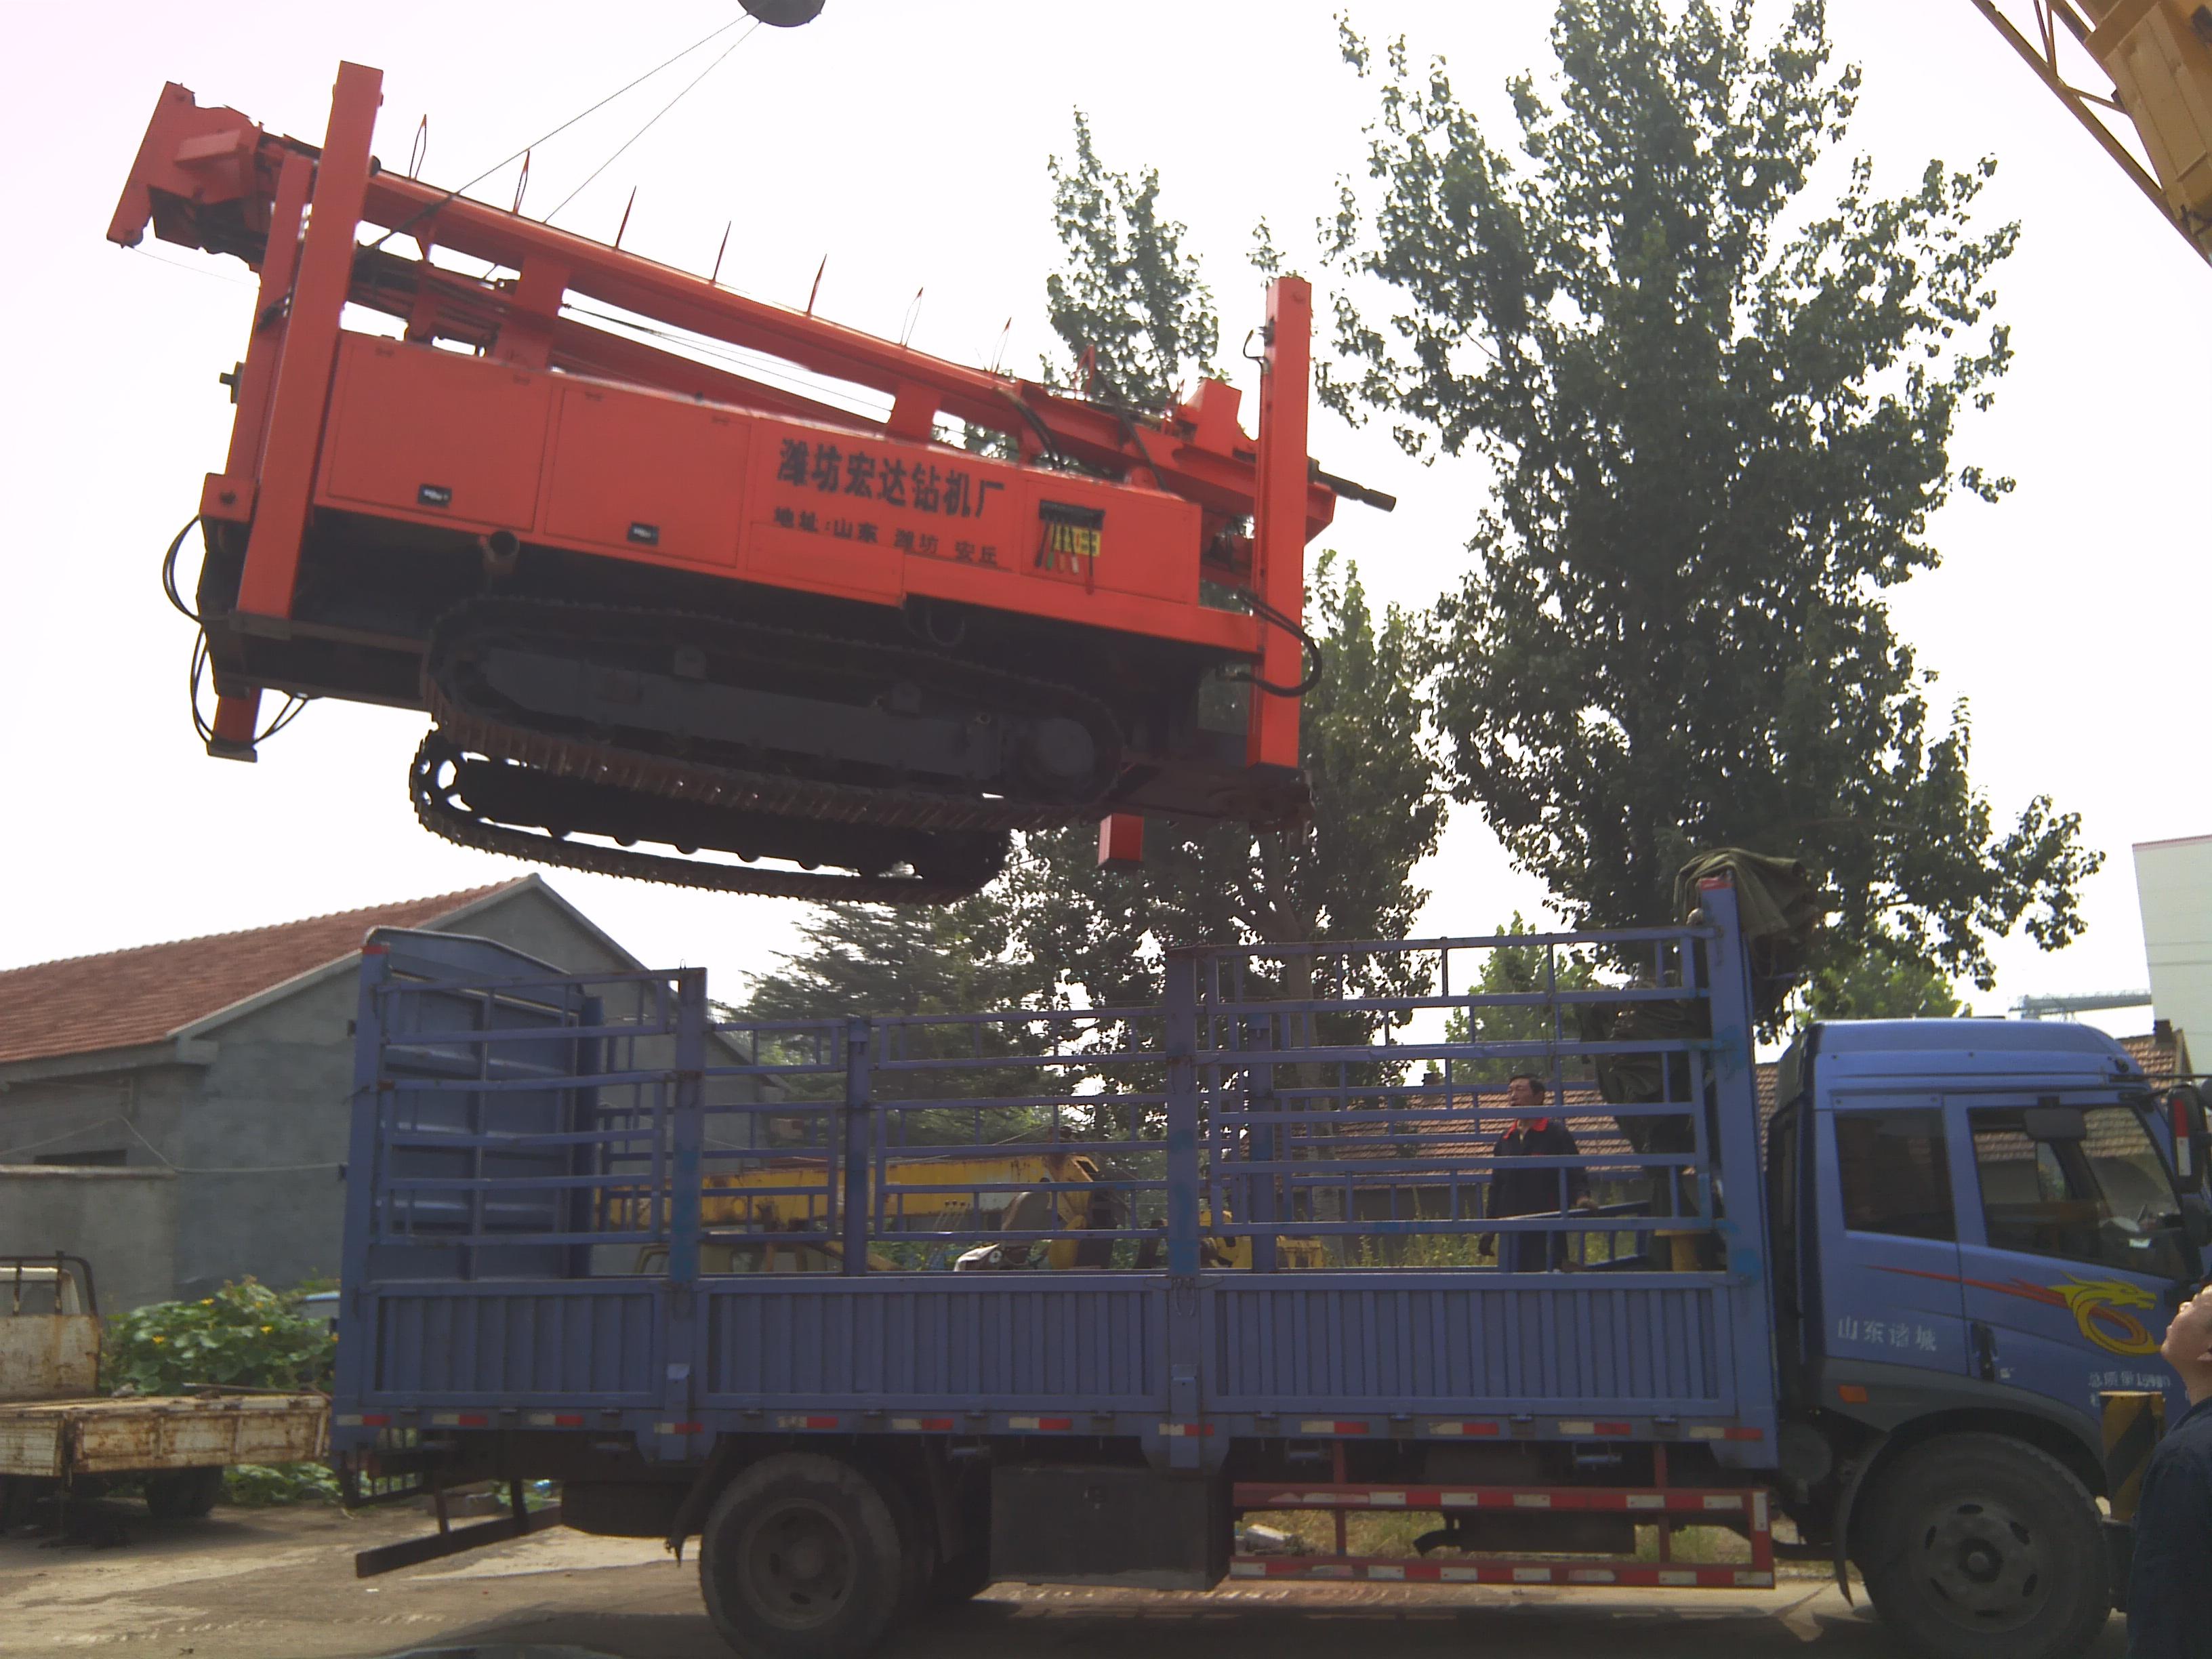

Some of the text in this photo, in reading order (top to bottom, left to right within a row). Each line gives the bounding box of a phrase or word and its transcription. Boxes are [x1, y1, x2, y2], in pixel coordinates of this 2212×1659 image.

[777, 438, 1005, 518] 潍坊宏达钻机厂
